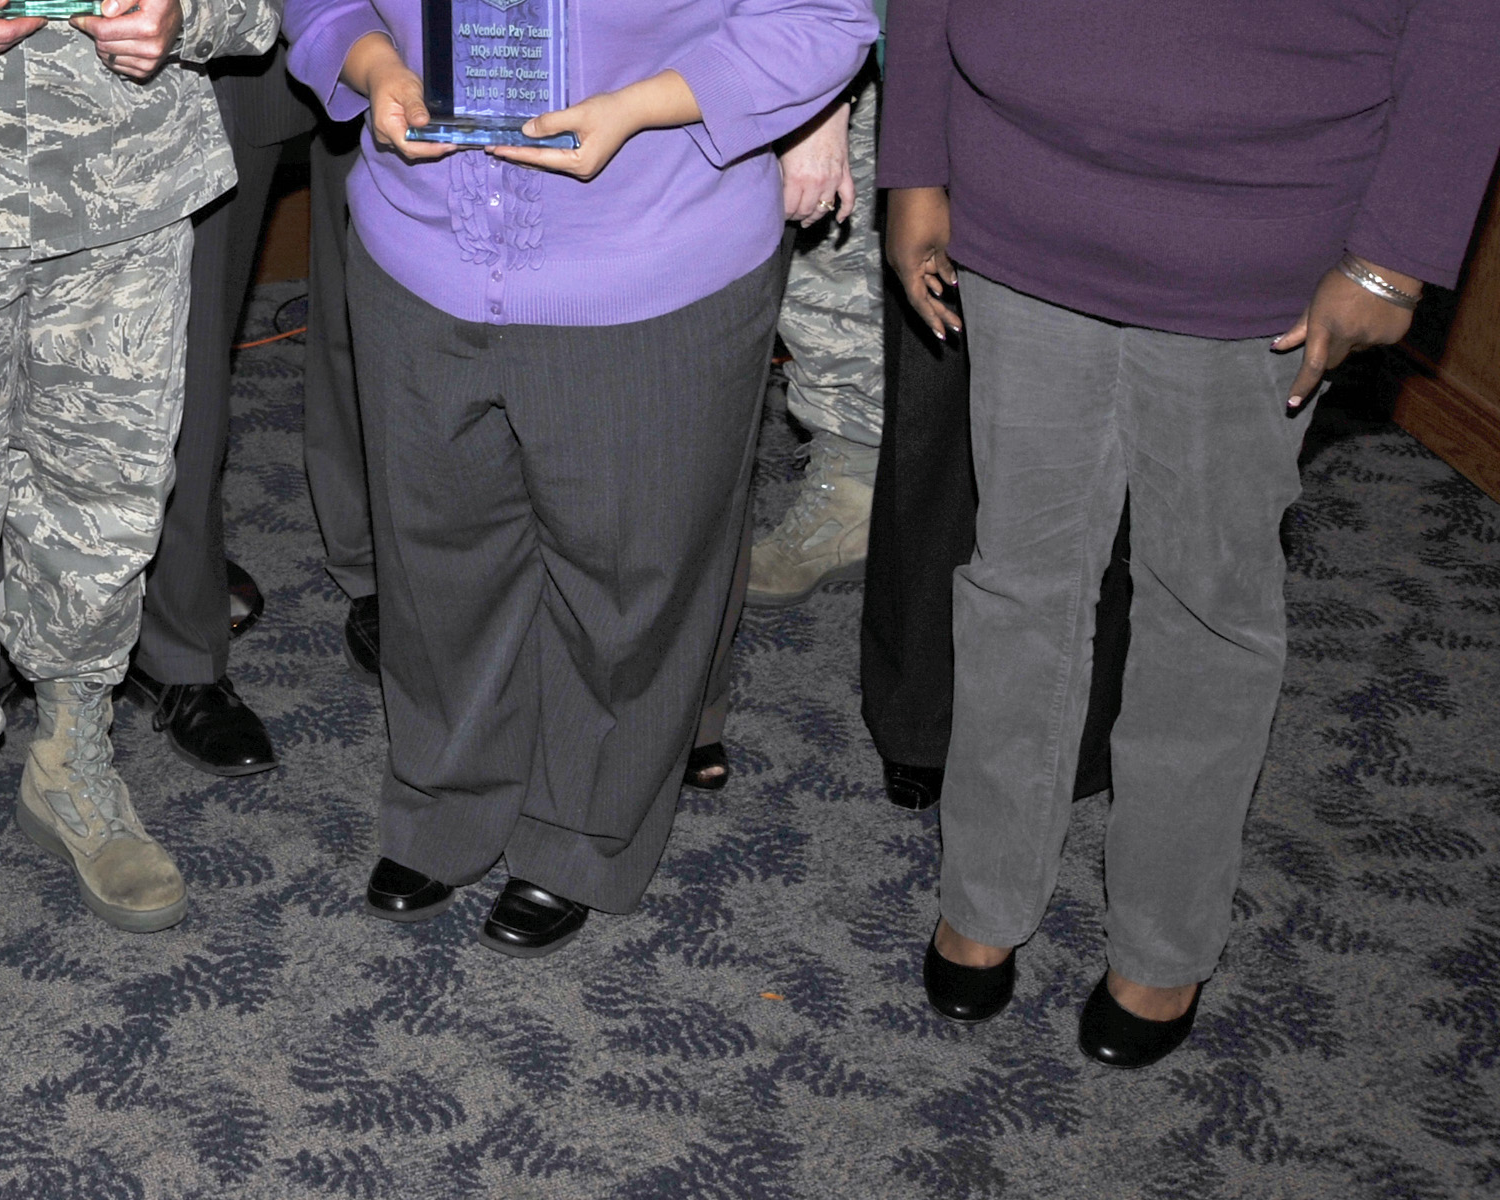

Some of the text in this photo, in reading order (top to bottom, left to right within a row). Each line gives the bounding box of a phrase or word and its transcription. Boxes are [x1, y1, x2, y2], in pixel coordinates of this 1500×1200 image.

[458, 23, 553, 41] A8 Vendor Pay Team
[470, 44, 543, 60] HQs AFDW Staff
[465, 65, 549, 82] Team of the Quarter
[472, 85, 486, 101] Jul
[488, 86, 499, 99] 10
[506, 87, 518, 100] 30
[519, 87, 537, 103] Sep
[539, 88, 550, 101] 10
